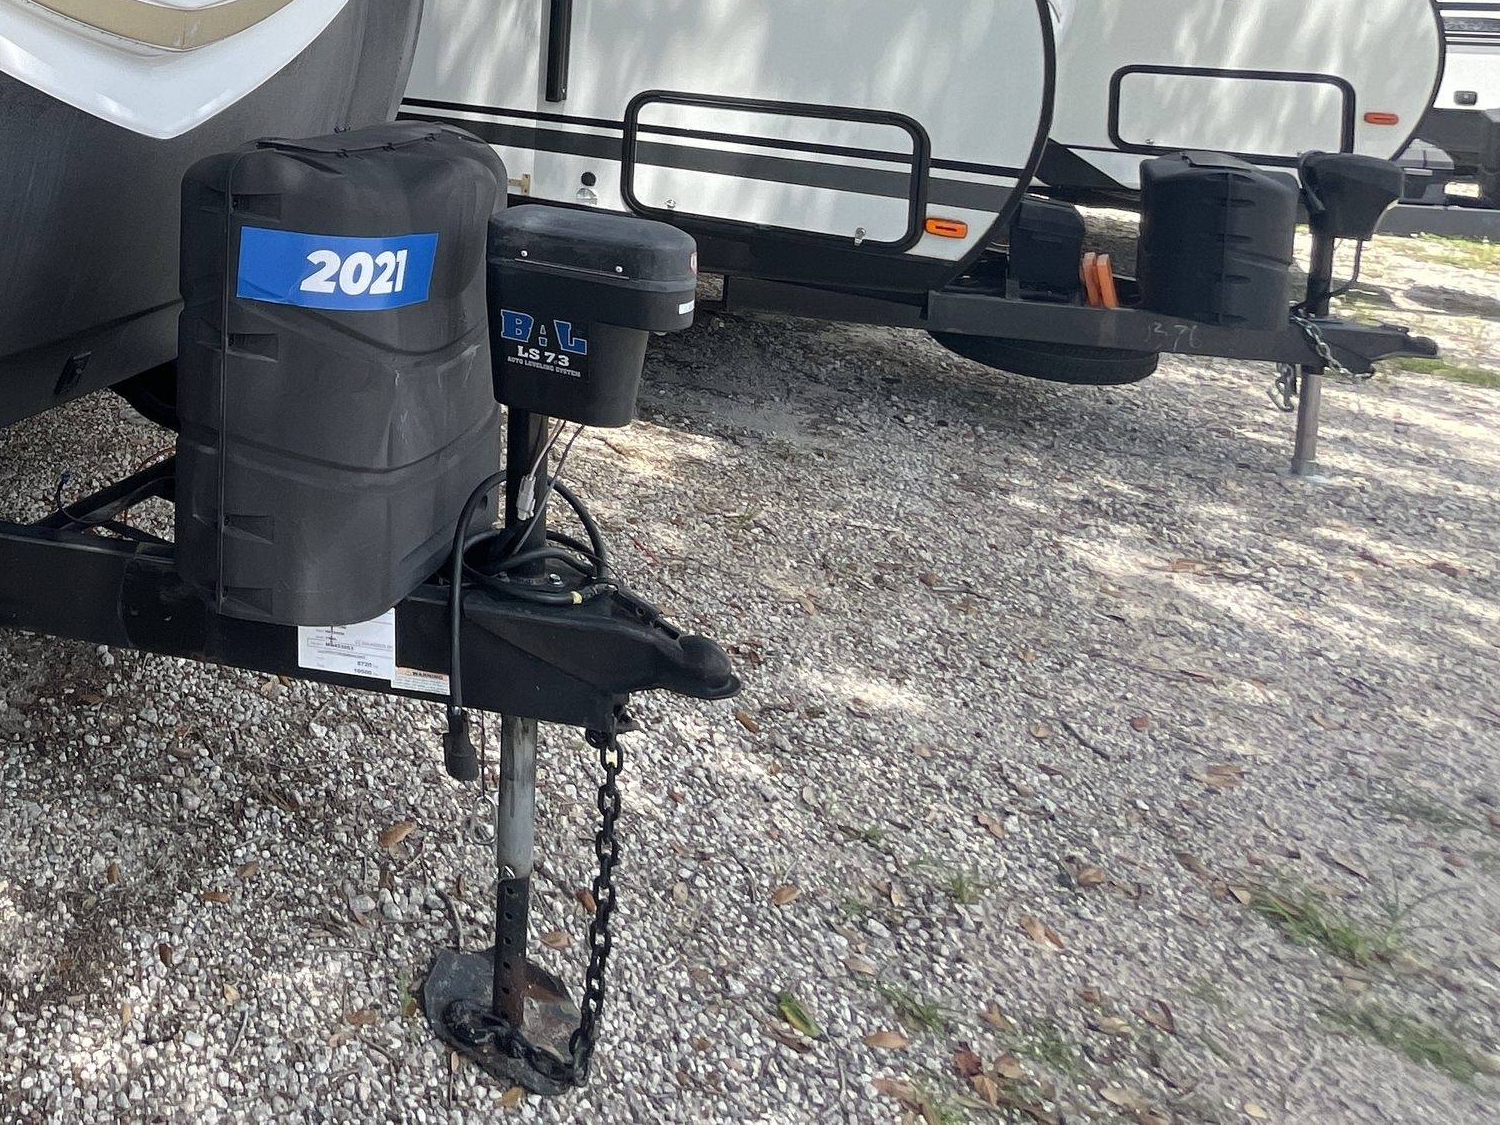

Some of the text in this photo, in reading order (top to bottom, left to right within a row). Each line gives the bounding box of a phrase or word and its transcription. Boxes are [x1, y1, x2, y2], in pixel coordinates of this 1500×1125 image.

[299, 249, 408, 296] 2021
[500, 308, 588, 356] BAL
[507, 355, 524, 365] AUTO
[517, 345, 541, 361] LS
[412, 671, 444, 680] WARNING
